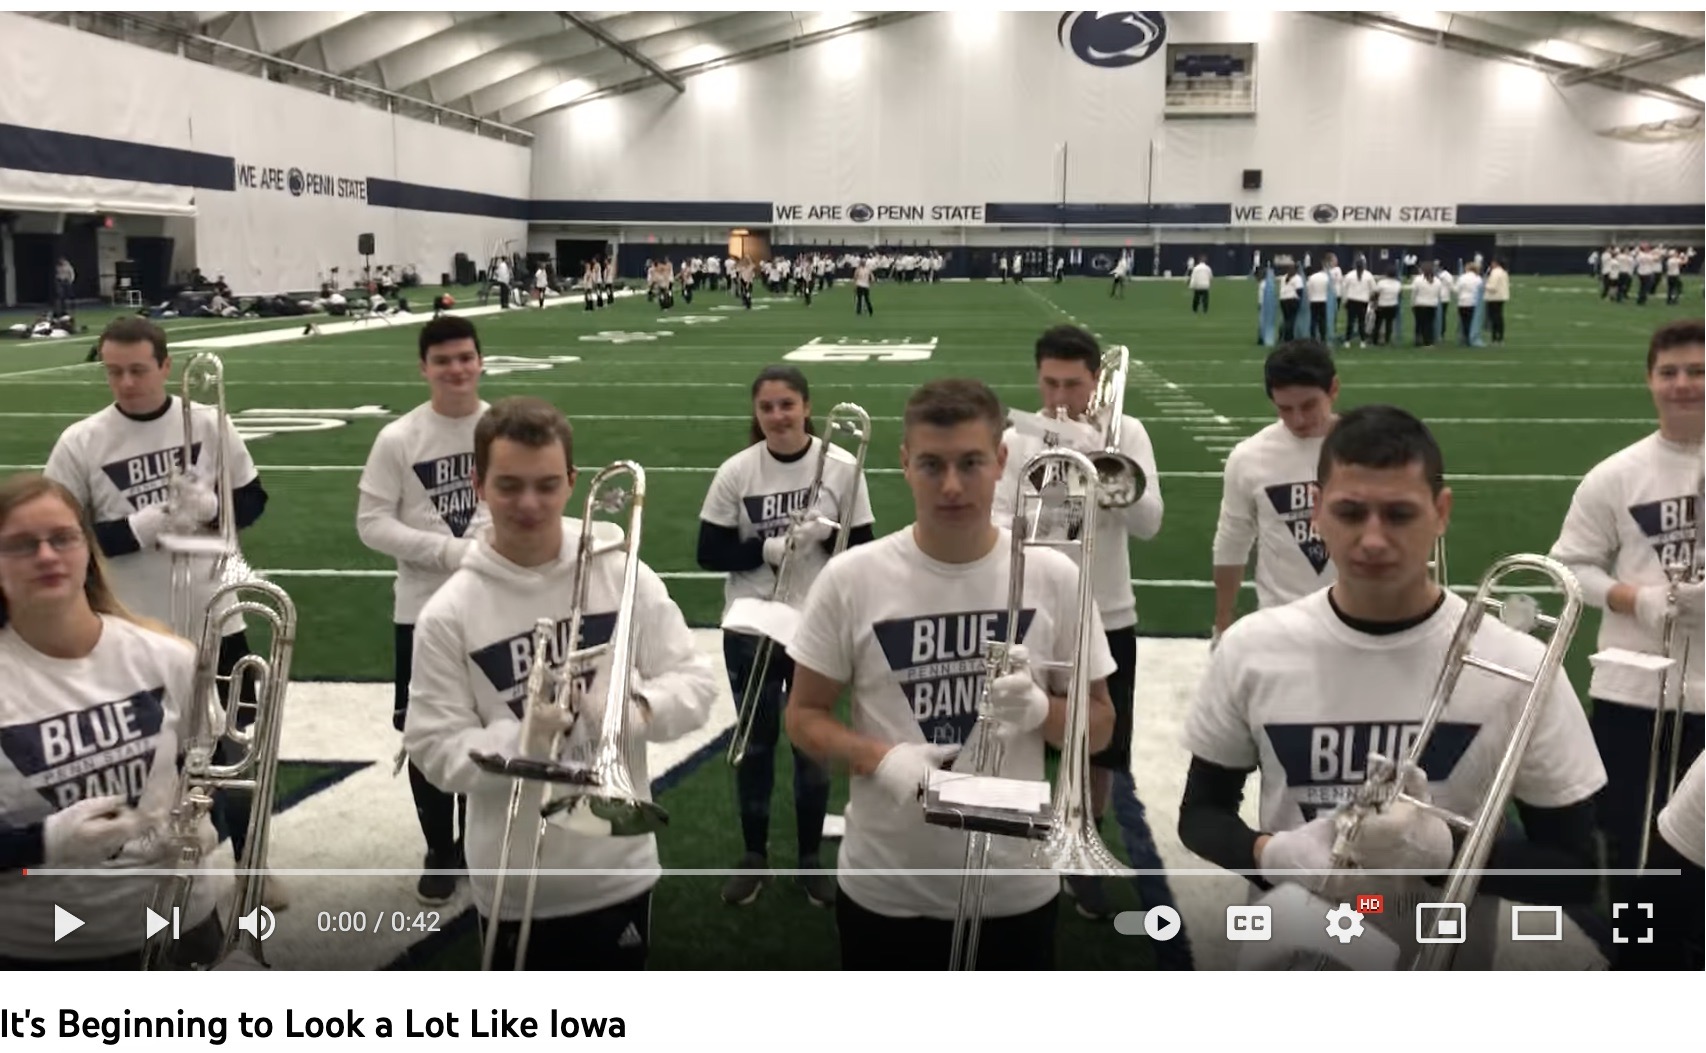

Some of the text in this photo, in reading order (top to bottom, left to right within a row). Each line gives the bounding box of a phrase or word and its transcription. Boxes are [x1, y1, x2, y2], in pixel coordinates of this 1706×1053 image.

[237, 164, 366, 200] WE ARE PENN STATE
[776, 205, 982, 220] WE ARE PENN STATE
[1235, 205, 1452, 222] WE ARE PENN STATE
[436, 453, 475, 485] BLU
[438, 488, 477, 515] BAN
[1290, 483, 1315, 510] BL
[1661, 498, 1697, 532] BL
[911, 613, 998, 664] BLUE
[907, 659, 987, 679] PENN STA
[40, 701, 142, 766] BLUE
